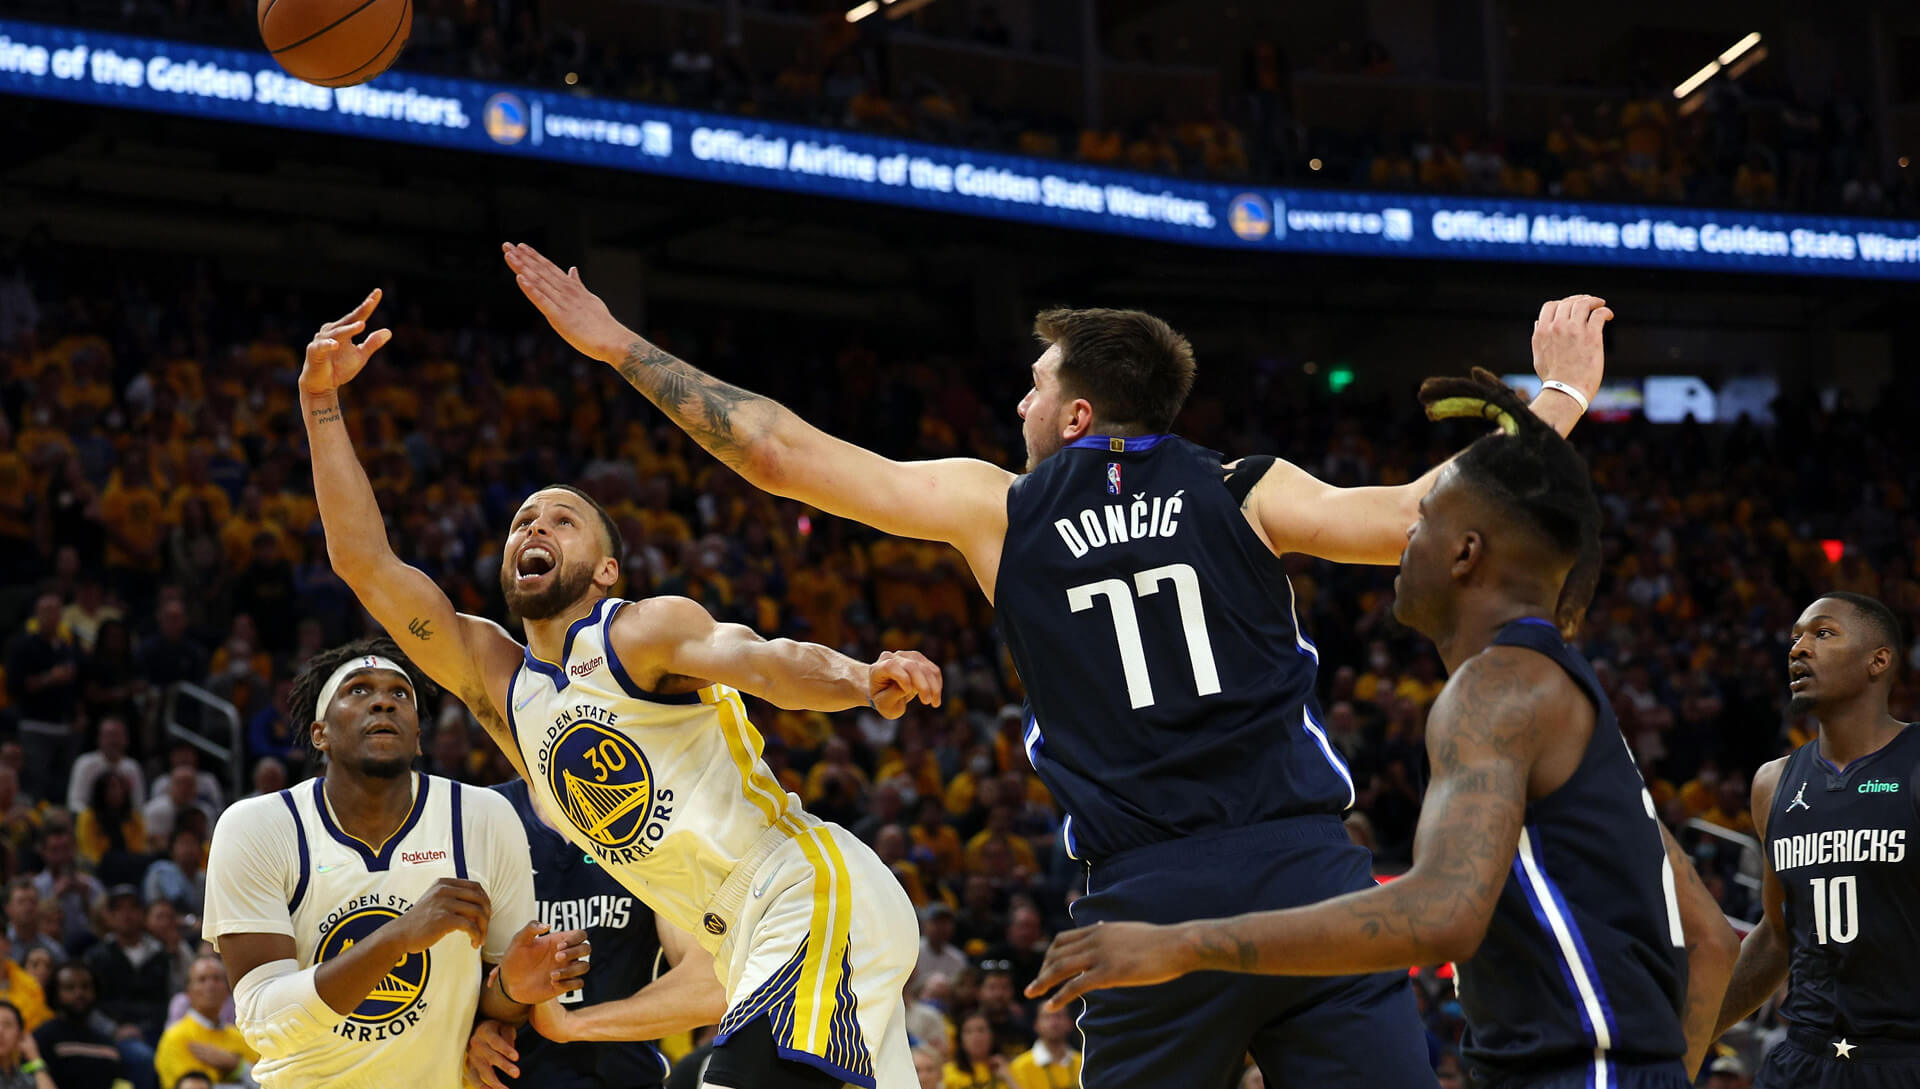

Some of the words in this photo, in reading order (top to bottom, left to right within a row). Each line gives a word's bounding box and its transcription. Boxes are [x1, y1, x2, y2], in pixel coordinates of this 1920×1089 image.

[51, 45, 89, 80] of
[91, 49, 145, 88] the
[147, 56, 254, 101] Golden
[254, 69, 333, 112] State
[333, 83, 470, 128] Warriors.
[545, 114, 642, 147] UNITED
[691, 127, 788, 171] Official
[788, 140, 877, 183] Airline
[877, 153, 909, 186] of
[909, 157, 954, 193] the
[954, 163, 1041, 204] Golden
[1041, 175, 1105, 213] State
[1104, 184, 1216, 229] Warriors.
[1287, 209, 1383, 234] UNITED
[1432, 209, 1529, 244] Official
[1530, 214, 1619, 249] Airline
[1621, 219, 1651, 249] of
[1653, 220, 1699, 252] the
[1700, 223, 1789, 256] Golden
[1790, 228, 1857, 260] State
[1054, 490, 1185, 559] DONČIĆ
[1066, 563, 1222, 710] 77
[570, 656, 603, 678] Rakuten
[537, 711, 573, 775] GOLDEN
[575, 705, 618, 726] STATE
[583, 739, 627, 783] 30
[1858, 780, 1900, 793] chime
[589, 788, 674, 866] WARRIORS
[401, 850, 447, 865] Rakuten
[1773, 829, 1906, 872] MAVERICKS
[319, 893, 380, 934] GOLDEN
[535, 895, 632, 934] VERICKS
[1809, 875, 1859, 945] 10
[333, 999, 428, 1042] RRIORS
